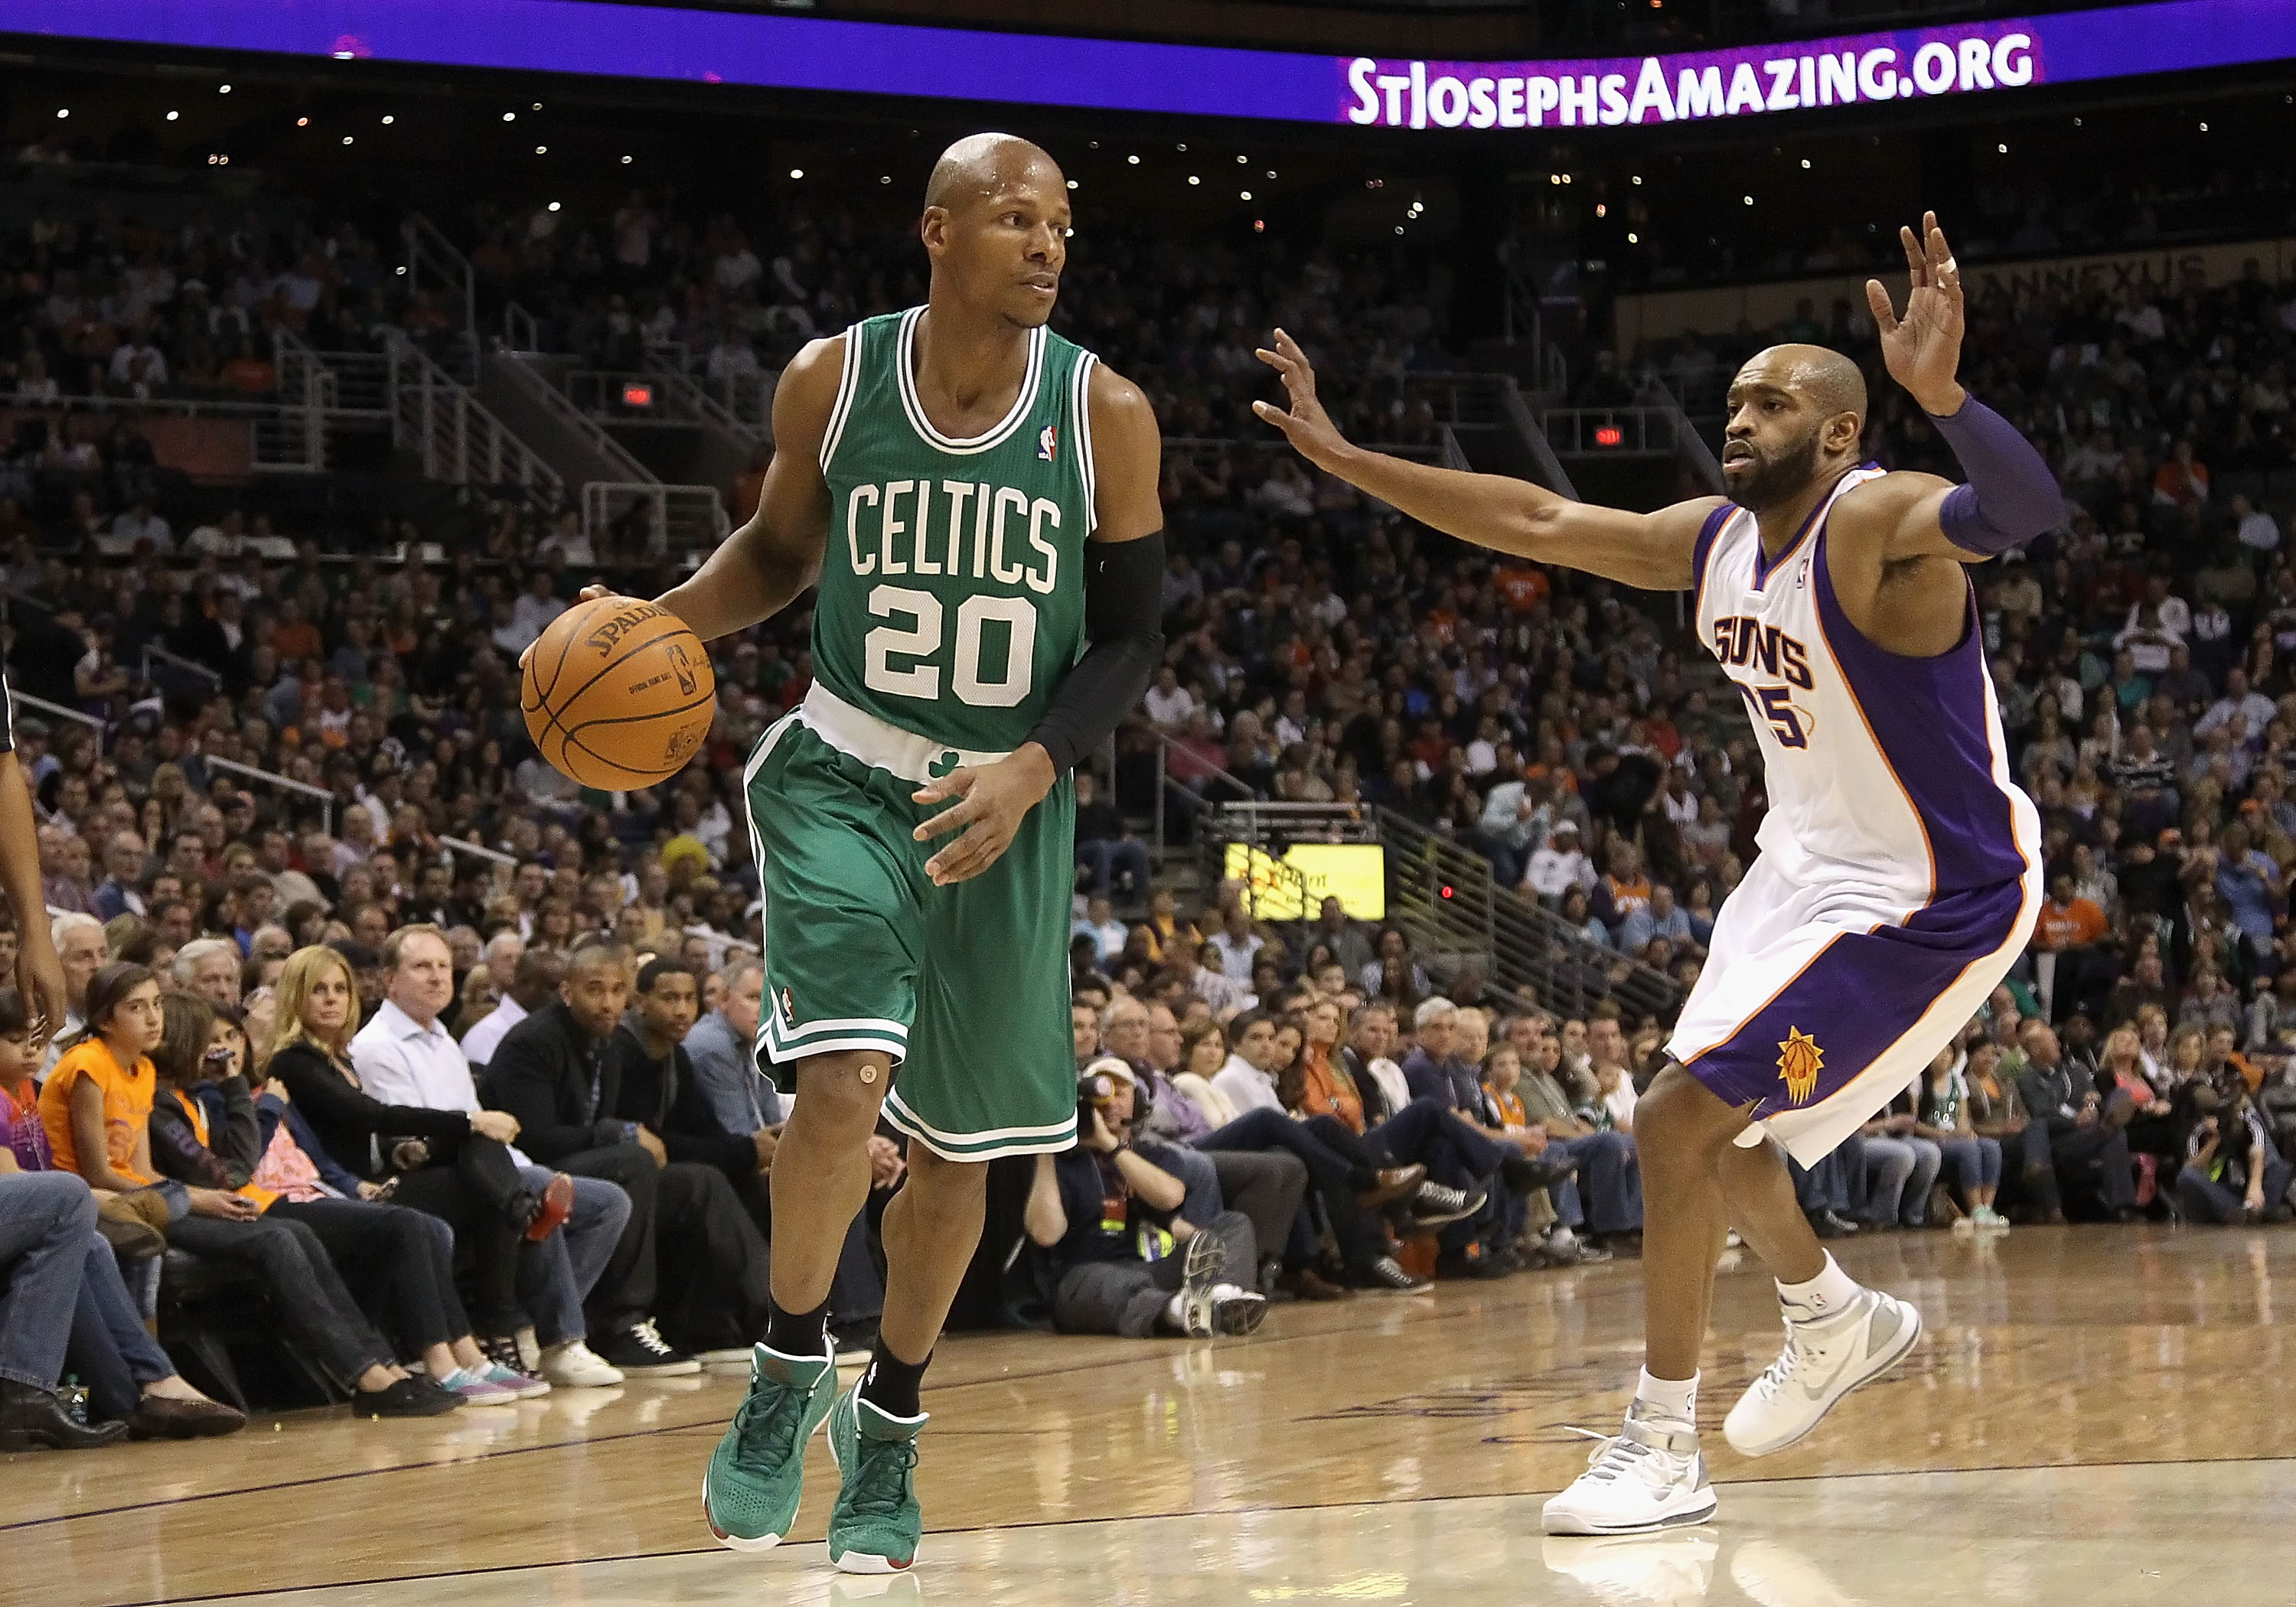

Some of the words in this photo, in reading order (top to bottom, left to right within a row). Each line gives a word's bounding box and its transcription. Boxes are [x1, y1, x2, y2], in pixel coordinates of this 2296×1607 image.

[846, 479, 1062, 595] CELTICS
[585, 602, 673, 658] SPALD
[864, 583, 1037, 708] 20
[1714, 615, 1816, 692] SUNS
